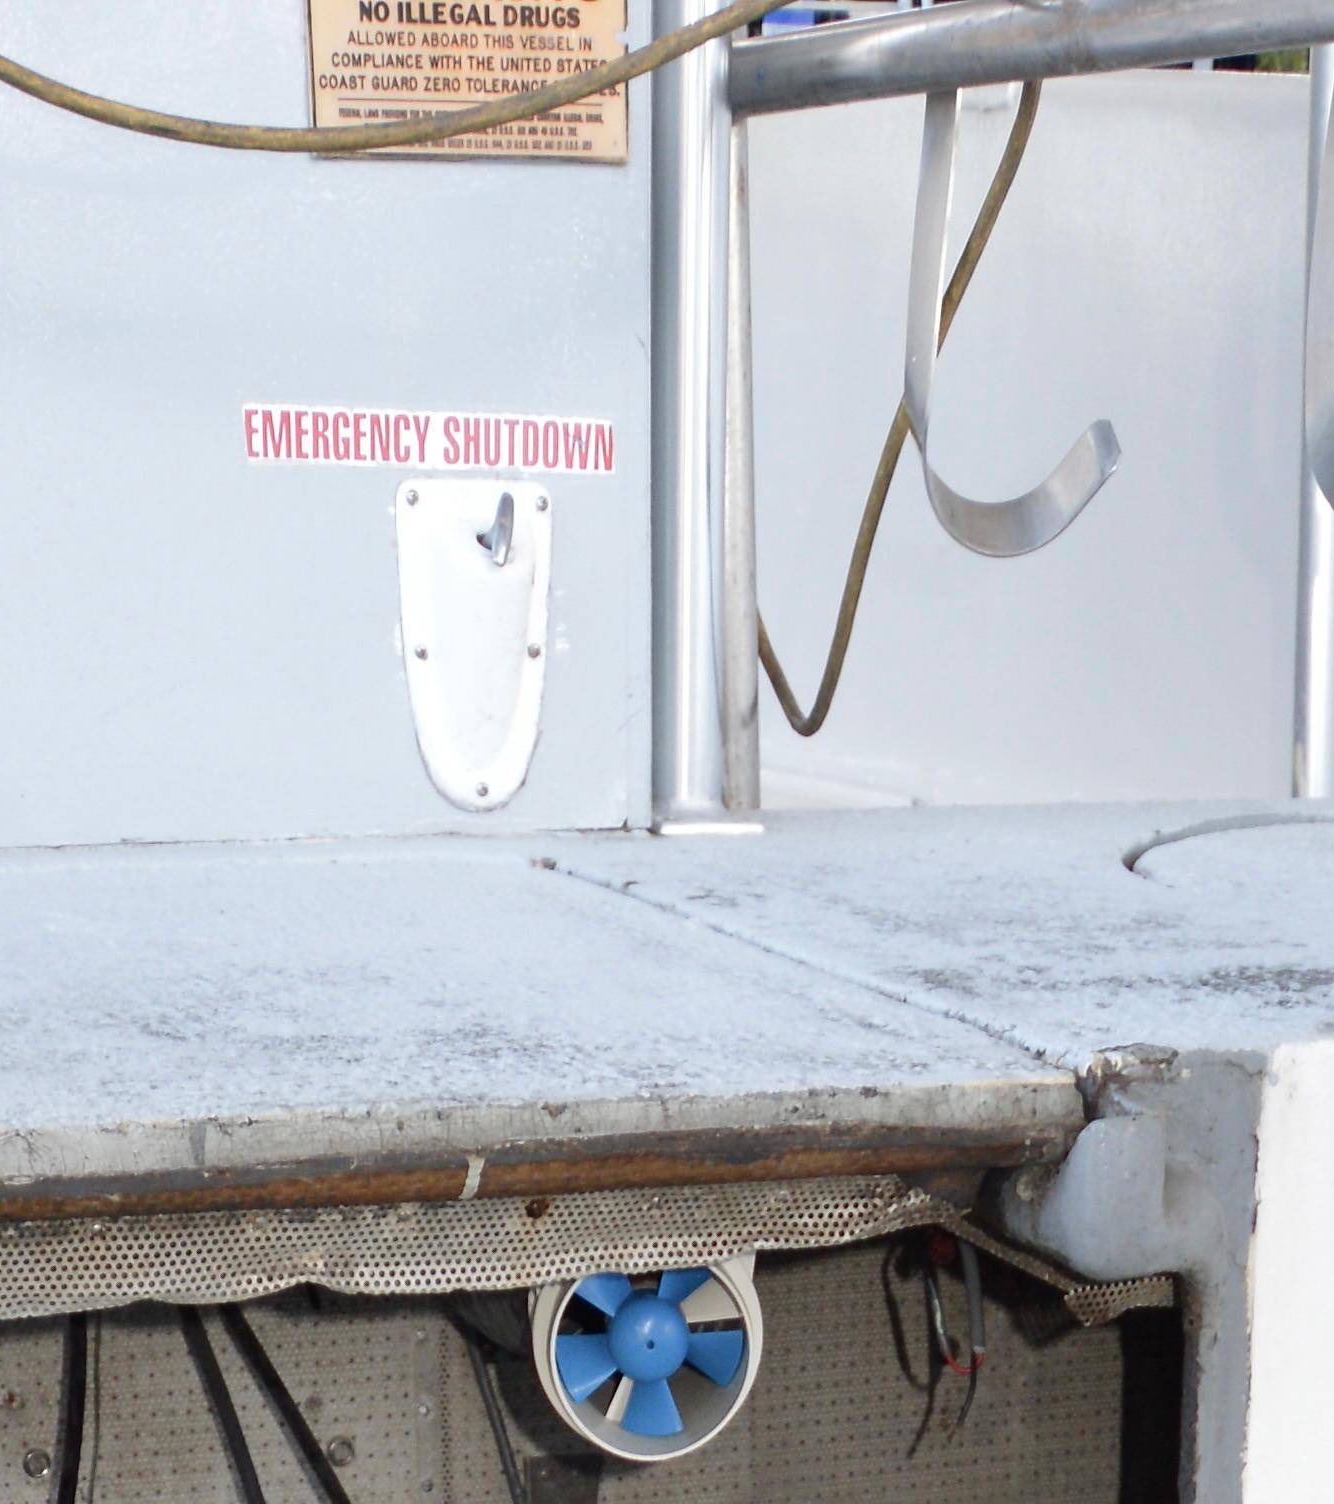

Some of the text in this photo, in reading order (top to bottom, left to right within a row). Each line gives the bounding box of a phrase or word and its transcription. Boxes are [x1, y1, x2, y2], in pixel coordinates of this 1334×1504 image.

[359, 1, 580, 28] NO ILLEGAL DRUGS
[347, 30, 592, 51] ALLOWED ABOARD THIS VESSEL IN
[331, 52, 424, 69] COMPLIANCE
[429, 55, 462, 70] WITH
[467, 56, 495, 71] THE
[501, 57, 552, 72] UNITED
[319, 74, 366, 90] COAST
[371, 75, 418, 91] GUARD
[424, 76, 461, 92] ZERO
[244, 408, 614, 471] EMERGENCY SHUTDOWN
